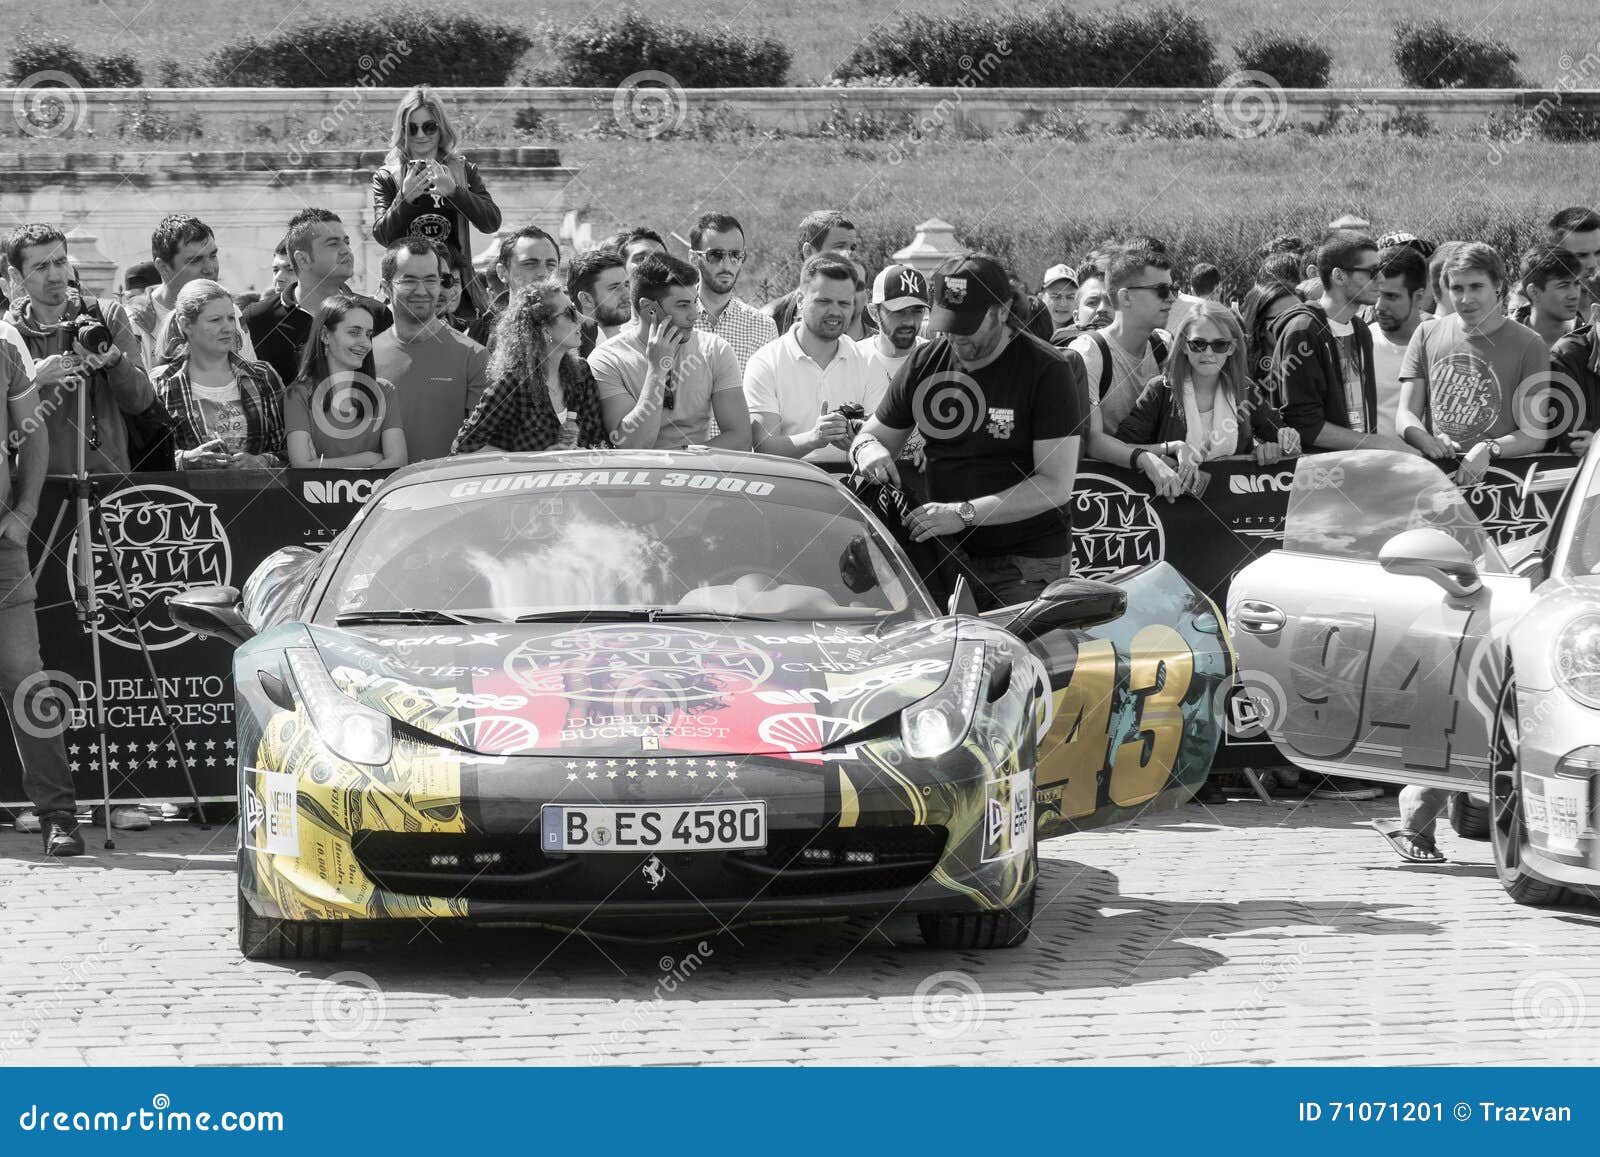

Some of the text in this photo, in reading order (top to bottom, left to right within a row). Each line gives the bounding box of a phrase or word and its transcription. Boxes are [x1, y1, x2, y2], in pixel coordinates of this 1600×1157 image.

[900, 270, 919, 294] NY
[449, 471, 776, 498] GUMBALL 3000
[185, 675, 224, 698] TO
[1285, 611, 1470, 773] 94
[559, 726, 731, 742] BUCHAREST
[567, 714, 719, 729] DUBLIN TO
[1035, 624, 1195, 819] 43
[566, 811, 589, 845] B
[615, 812, 662, 846] ES
[671, 808, 760, 845] 4580
